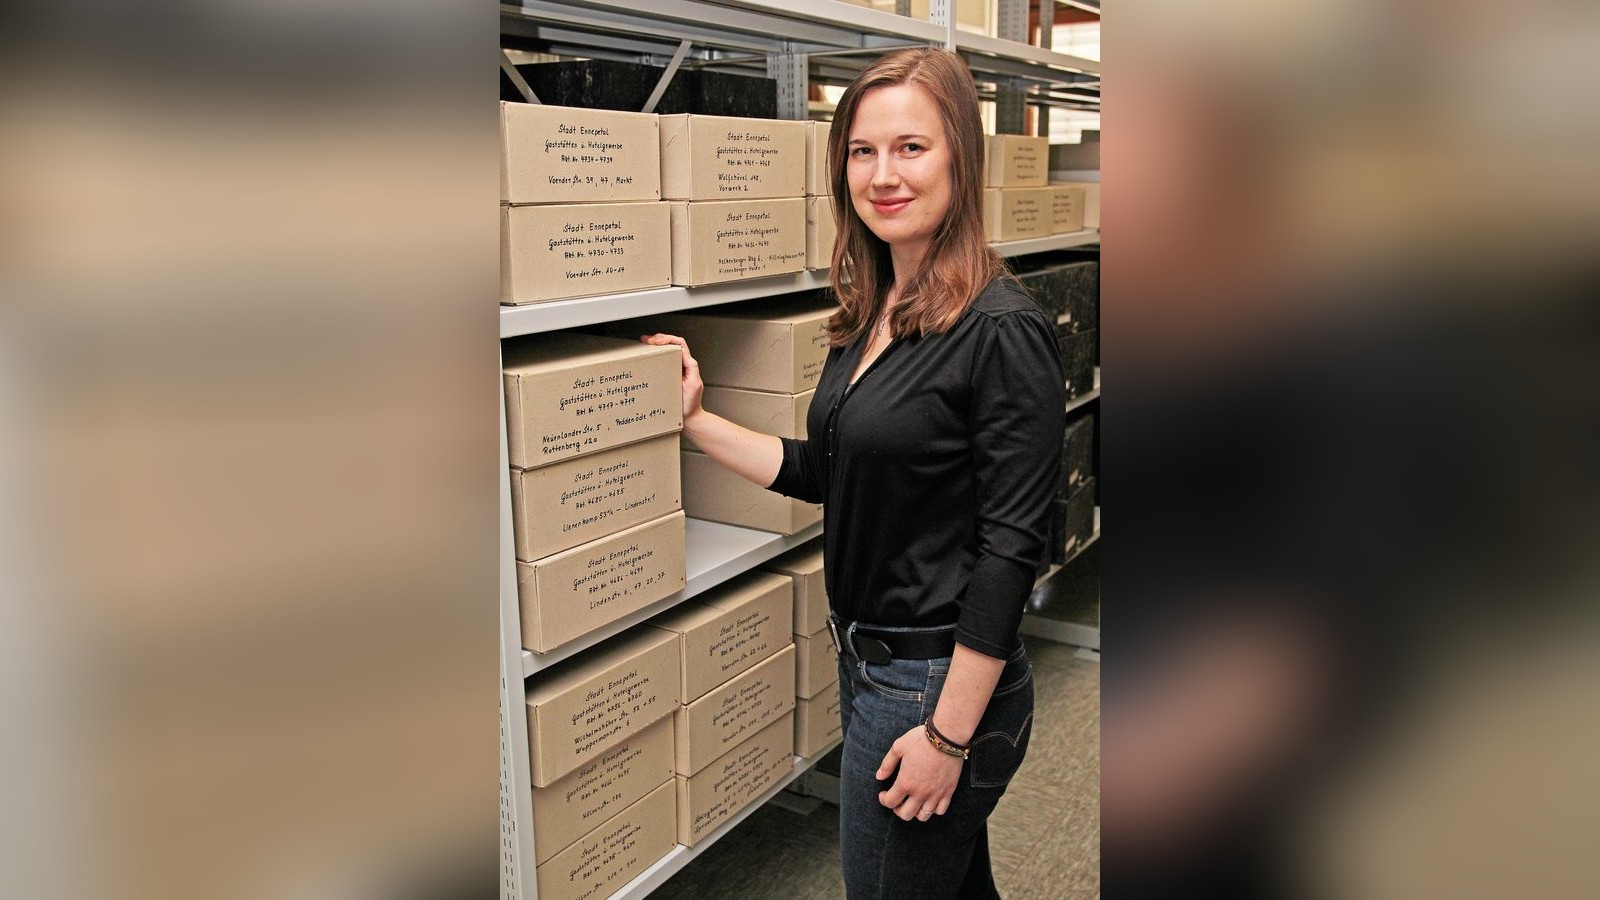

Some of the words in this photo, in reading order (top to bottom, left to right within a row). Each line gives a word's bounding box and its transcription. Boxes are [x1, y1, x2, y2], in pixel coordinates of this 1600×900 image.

[558, 123, 576, 134] Stadt
[580, 126, 610, 136] Ennepetal
[727, 131, 744, 142] Stadt
[745, 132, 771, 143] Ennepetal
[545, 140, 577, 153] Gaststätten
[588, 142, 623, 153] Hotelgewerbe
[716, 146, 743, 159] Gaststätten
[615, 177, 633, 185] Markt
[719, 184, 742, 192] Vorwerk
[726, 213, 742, 222] Stadt
[745, 212, 771, 222] Ennepetal
[563, 222, 585, 233] Stadt
[589, 220, 622, 232] Ennepetal
[548, 238, 584, 251] Gaststätten
[594, 235, 635, 246] Hotelgewerbe
[716, 229, 744, 242] Gaststätten
[591, 267, 604, 277] Str.
[573, 377, 595, 389] Stadt
[599, 370, 633, 385] Ennepetal
[559, 393, 597, 411] Gaststätten
[606, 382, 649, 397] Hotelgewerbe
[582, 422, 596, 435] Str.
[542, 440, 581, 456] Rottenberg
[574, 471, 594, 483] Stadt
[598, 459, 629, 476] Ennepetal
[560, 485, 596, 505] Gaststätten
[605, 469, 644, 486] Hotelgewerbe
[587, 556, 606, 569] Stadt
[609, 544, 639, 561] Ennepetal
[573, 568, 608, 591] Gaststätten
[617, 550, 653, 568] Hotelgewerbe
[585, 685, 605, 702] Stadt
[608, 669, 638, 689] Ennepetal
[571, 700, 606, 726] Gaststätten
[613, 677, 650, 697] Hotelgewerbe
[578, 763, 597, 779] Stadt
[602, 744, 629, 766] Ennepetal
[581, 843, 599, 859] Stadt
